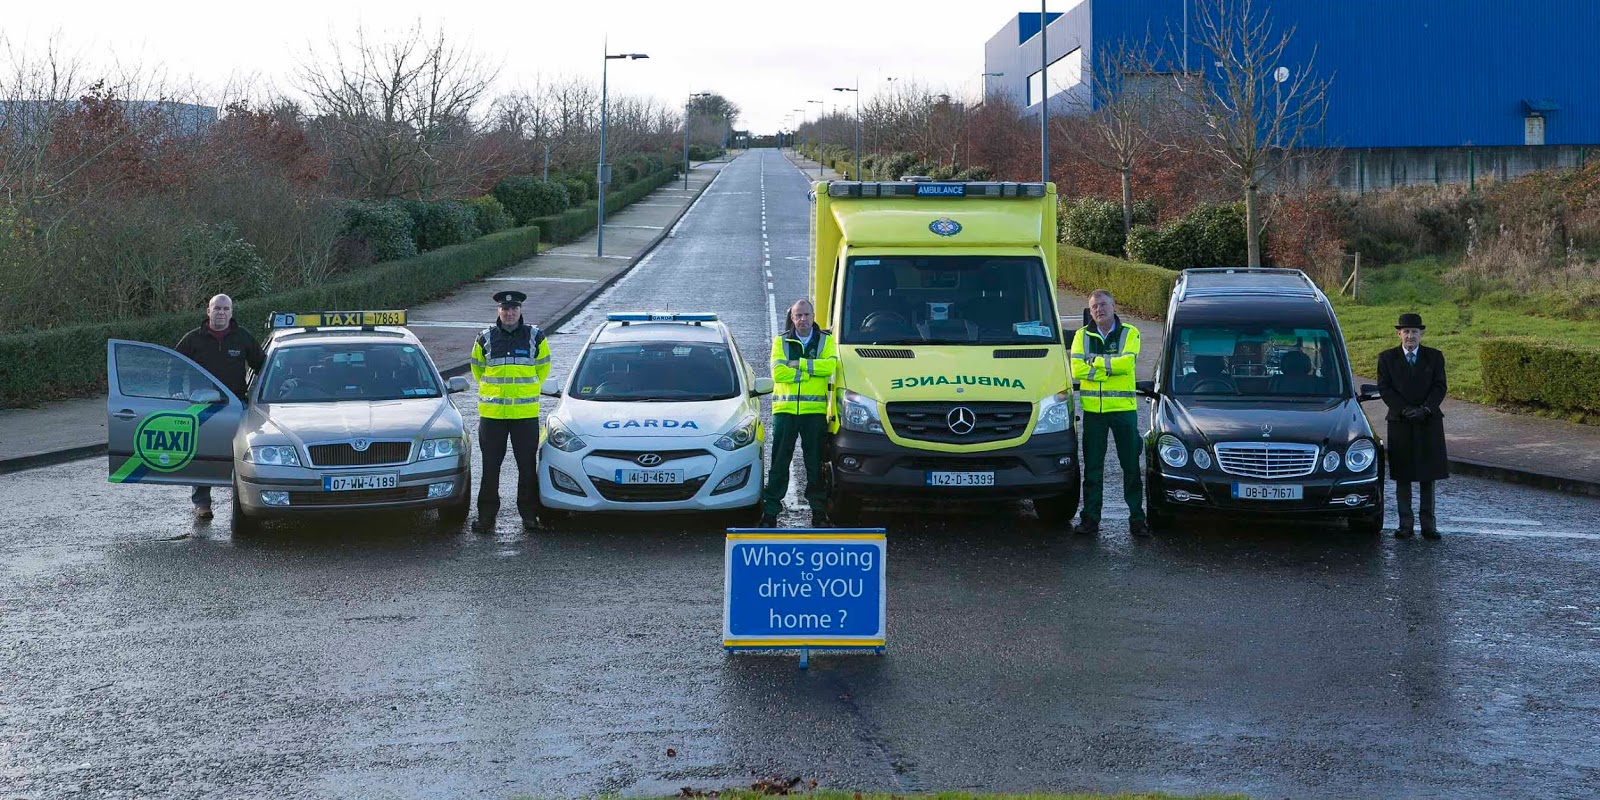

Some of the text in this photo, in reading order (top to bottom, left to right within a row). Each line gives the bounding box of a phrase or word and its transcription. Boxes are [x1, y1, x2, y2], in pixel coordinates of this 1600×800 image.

[917, 186, 964, 194] AMBULANCE
[285, 312, 399, 325] D TAXI 17863
[603, 419, 699, 429] GARDA
[143, 430, 190, 451] TAXI
[333, 476, 395, 489] 07-WW-4189
[628, 472, 676, 482] 141-D-4679
[933, 474, 993, 485] 142-D-3399
[742, 546, 873, 571] Who's going
[801, 571, 814, 581] to
[758, 577, 863, 598] drive YOU
[769, 608, 832, 628] home
